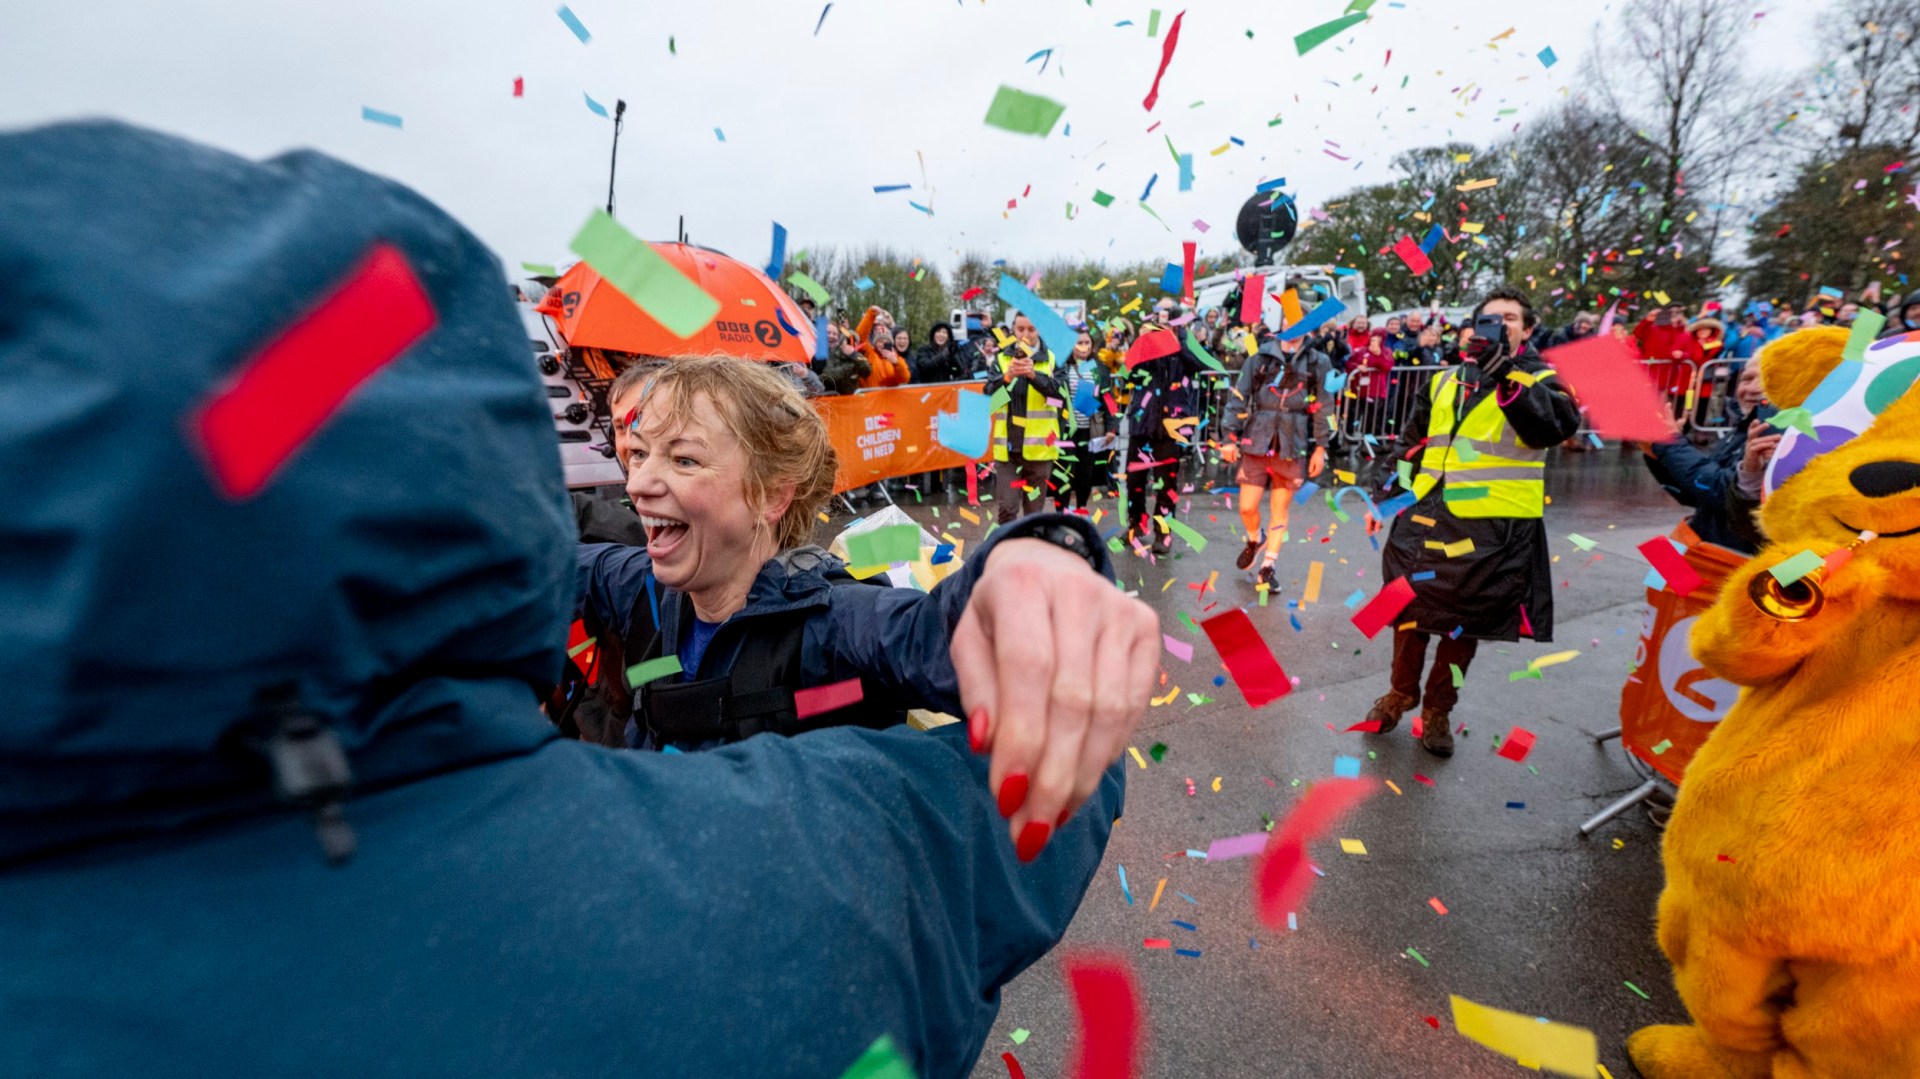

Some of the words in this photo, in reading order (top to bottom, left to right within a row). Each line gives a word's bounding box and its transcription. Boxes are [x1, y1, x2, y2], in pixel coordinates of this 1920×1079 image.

[717, 321, 750, 333] BBC
[757, 321, 780, 346] 2
[720, 332, 754, 343] RADIO
[857, 428, 902, 448] CHILDREN
[863, 447, 873, 461] IN
[874, 443, 895, 458] NEED
